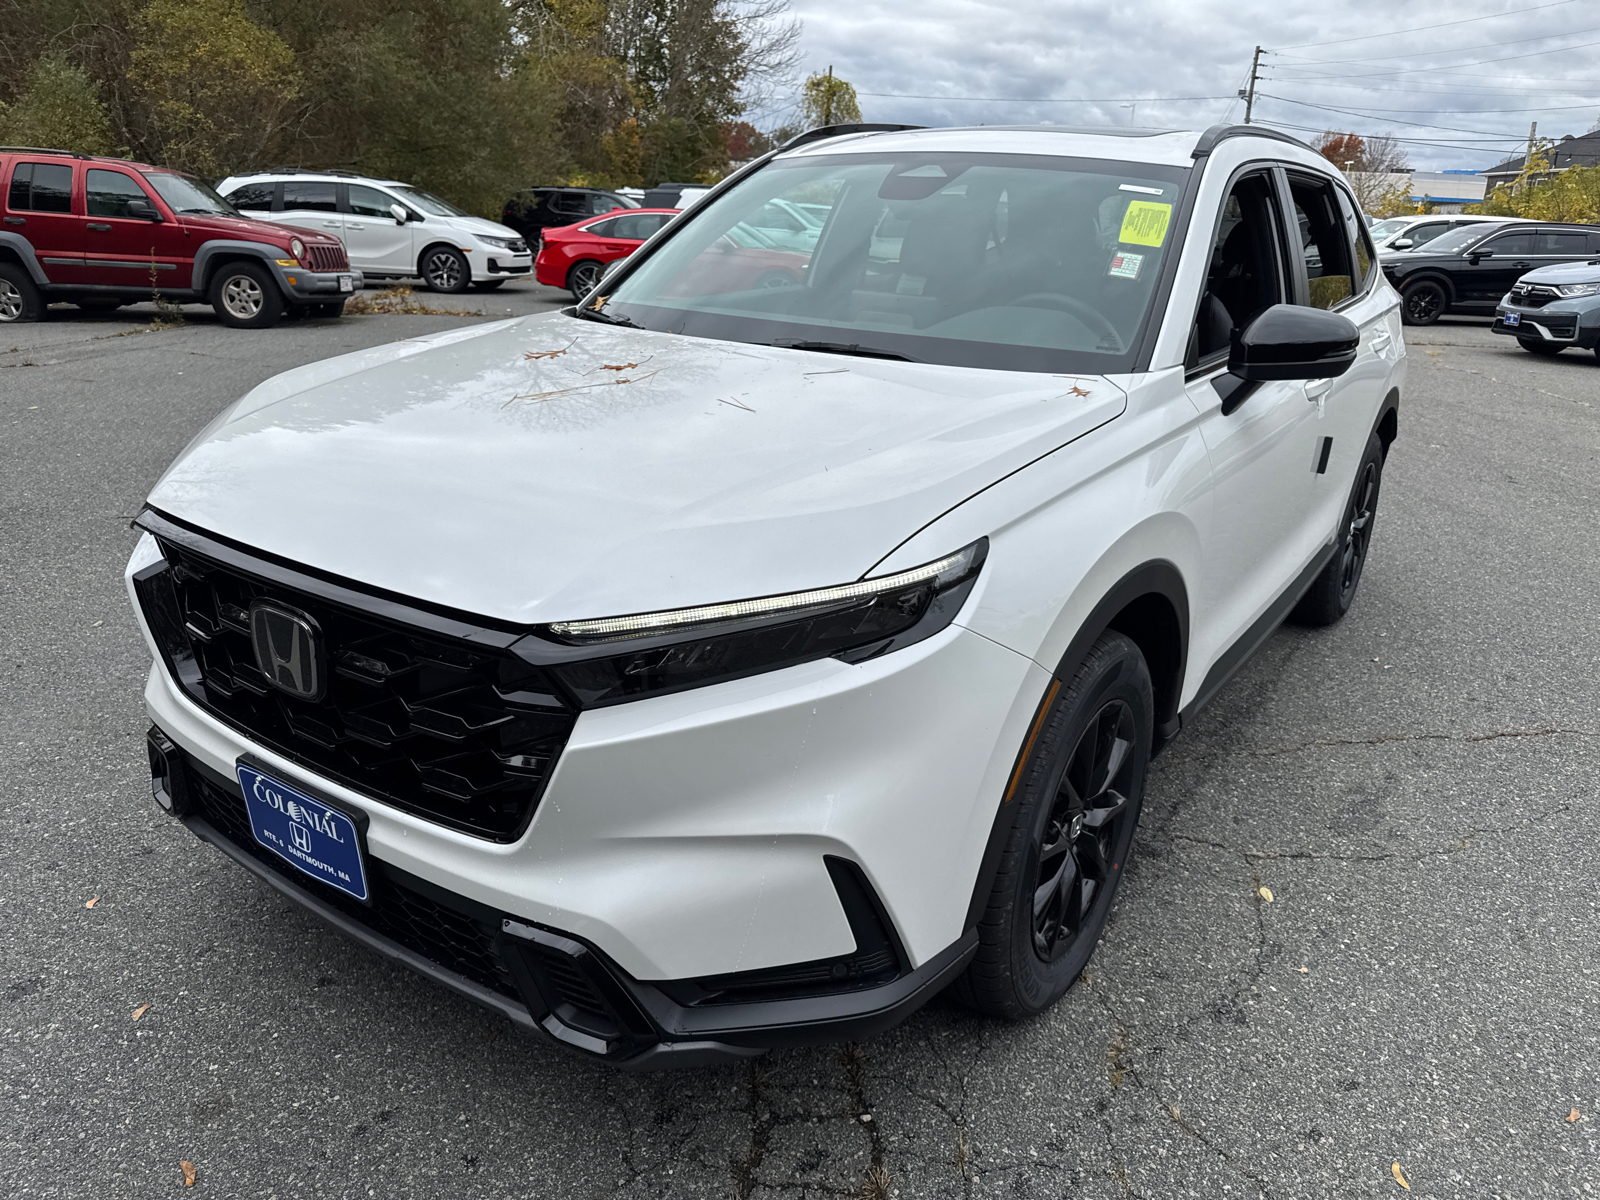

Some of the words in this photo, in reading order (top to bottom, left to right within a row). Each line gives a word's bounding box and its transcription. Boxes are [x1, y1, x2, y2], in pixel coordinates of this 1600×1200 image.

[263, 829, 279, 844] RTE.
[288, 844, 337, 877] DARTMOUTH,
[337, 869, 351, 882] MA
